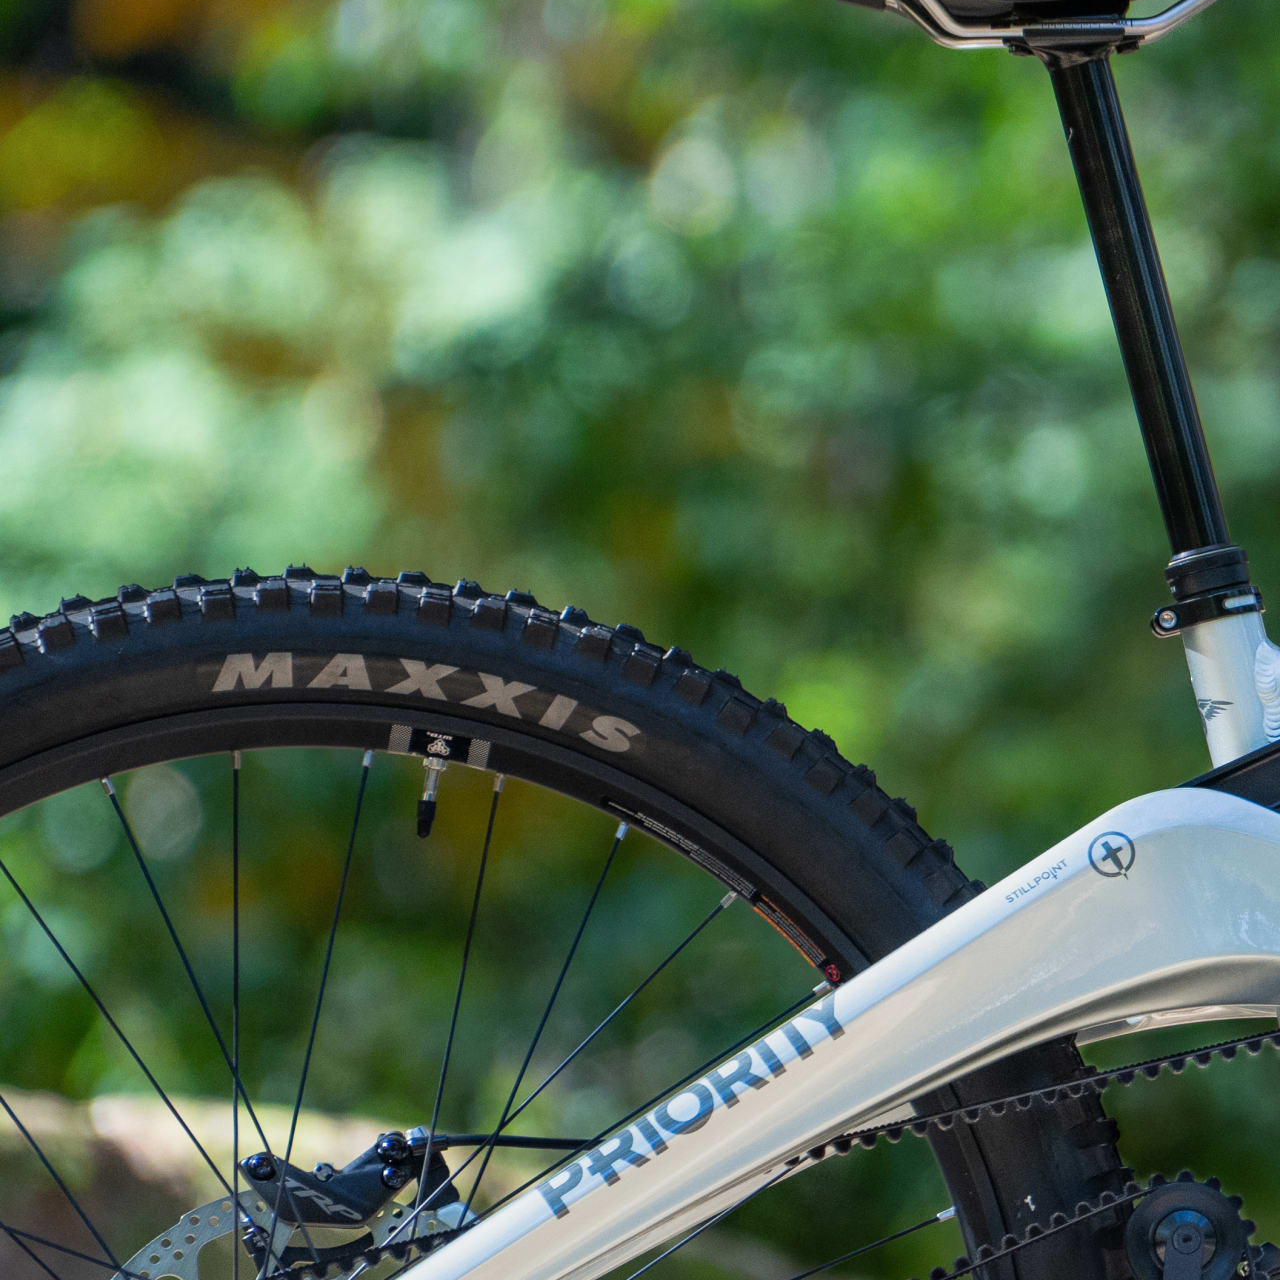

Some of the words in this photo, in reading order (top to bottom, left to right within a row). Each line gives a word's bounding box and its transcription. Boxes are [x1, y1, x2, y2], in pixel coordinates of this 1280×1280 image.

[211, 652, 641, 753] MAXXIS
[1004, 858, 1068, 903] STILLPOINT
[535, 989, 846, 1220] PRIORITY
[275, 1176, 363, 1221] TRP
